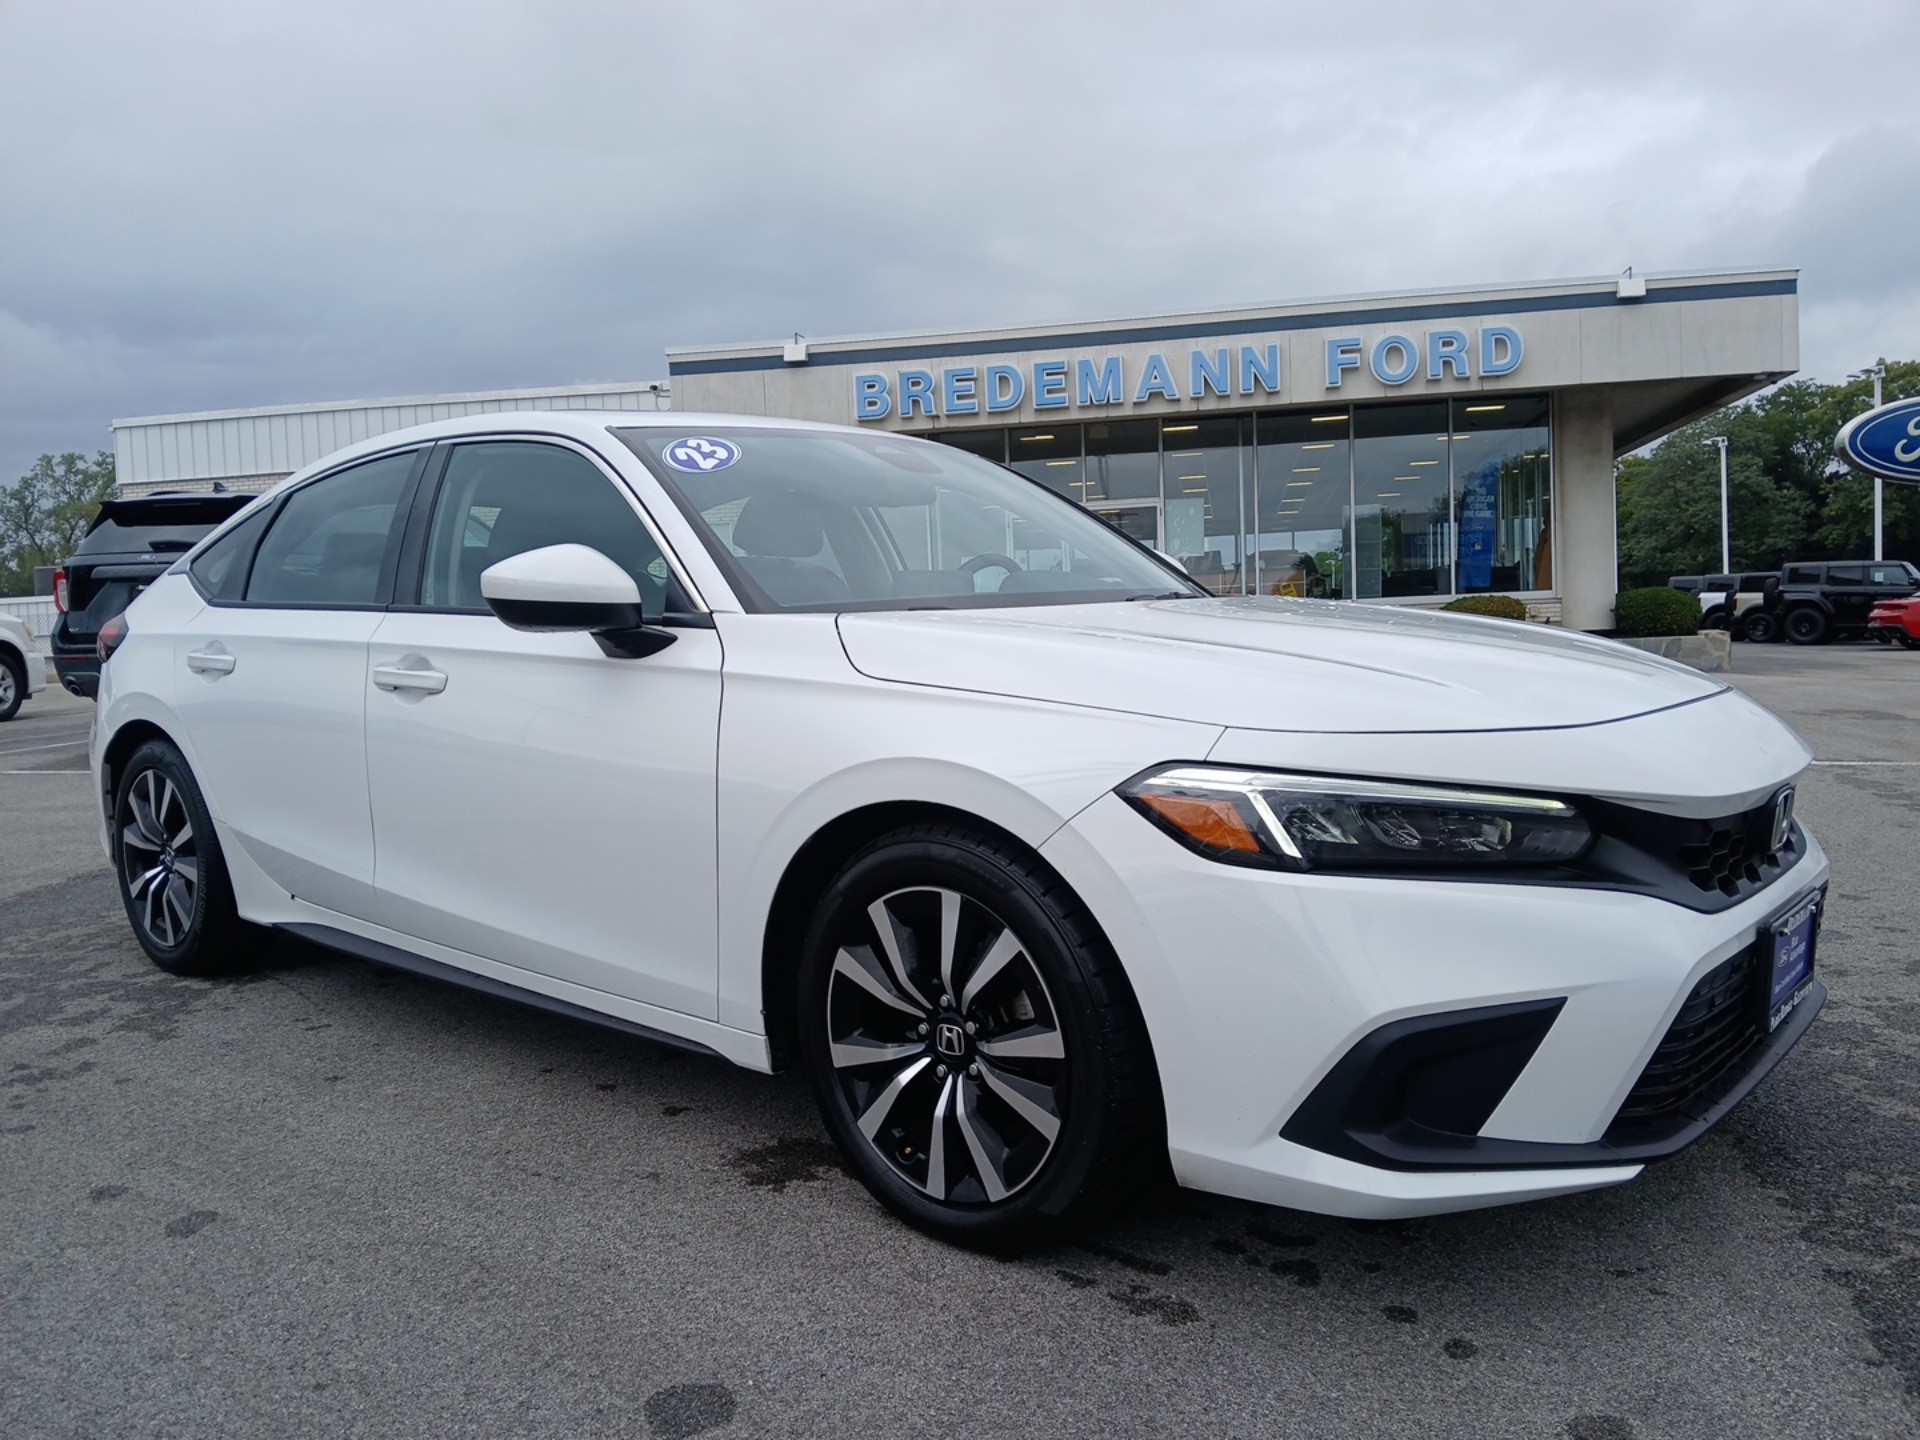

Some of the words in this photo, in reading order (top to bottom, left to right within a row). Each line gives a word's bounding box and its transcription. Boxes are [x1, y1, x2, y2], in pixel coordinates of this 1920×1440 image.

[855, 343, 1281, 420] BREDEMANN
[1325, 324, 1524, 388] FORD
[674, 439, 728, 470] 23
